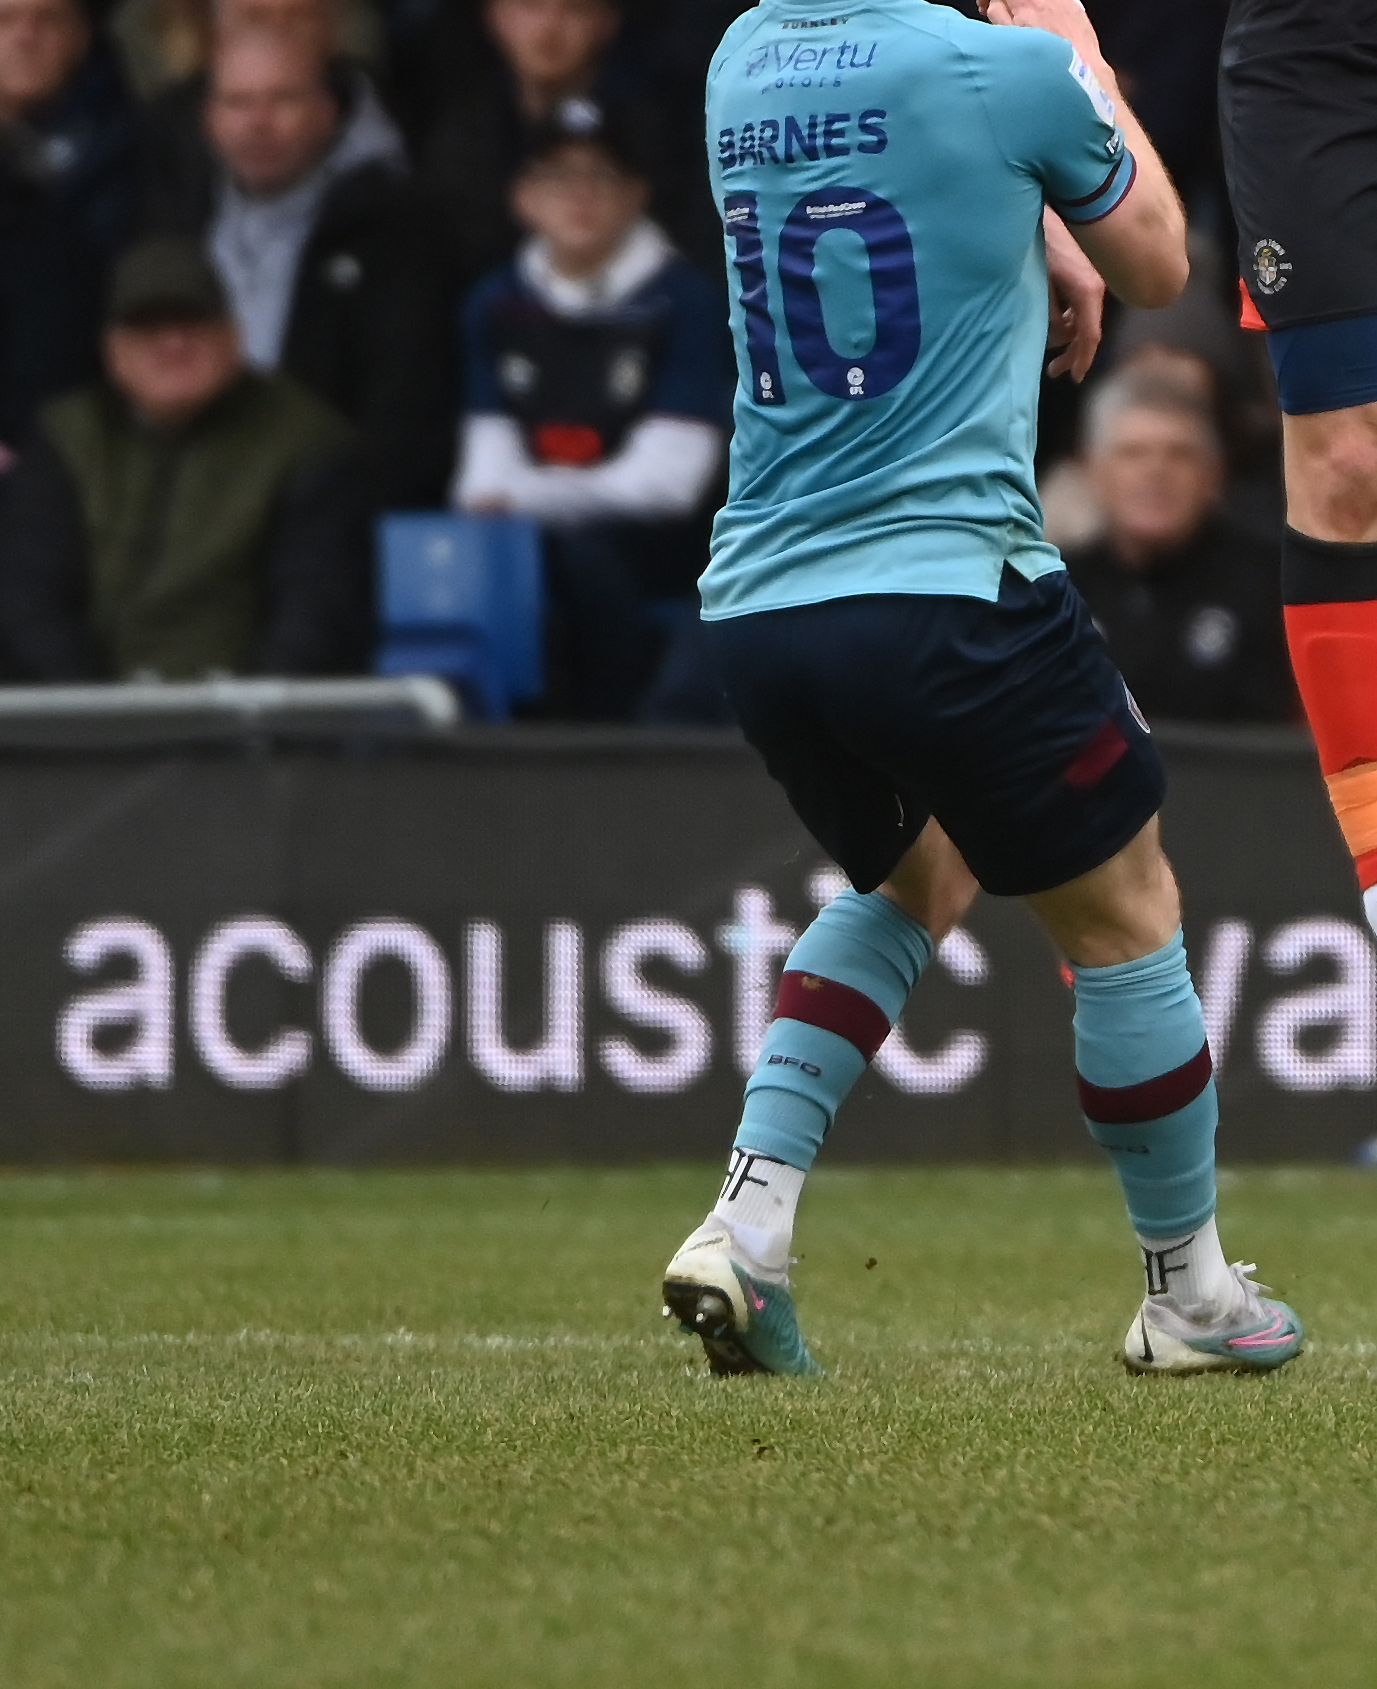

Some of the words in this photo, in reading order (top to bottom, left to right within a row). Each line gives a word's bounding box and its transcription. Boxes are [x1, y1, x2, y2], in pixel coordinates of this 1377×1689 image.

[773, 40, 877, 73] Vertu
[718, 108, 888, 170] BARNES
[723, 186, 921, 405] 10
